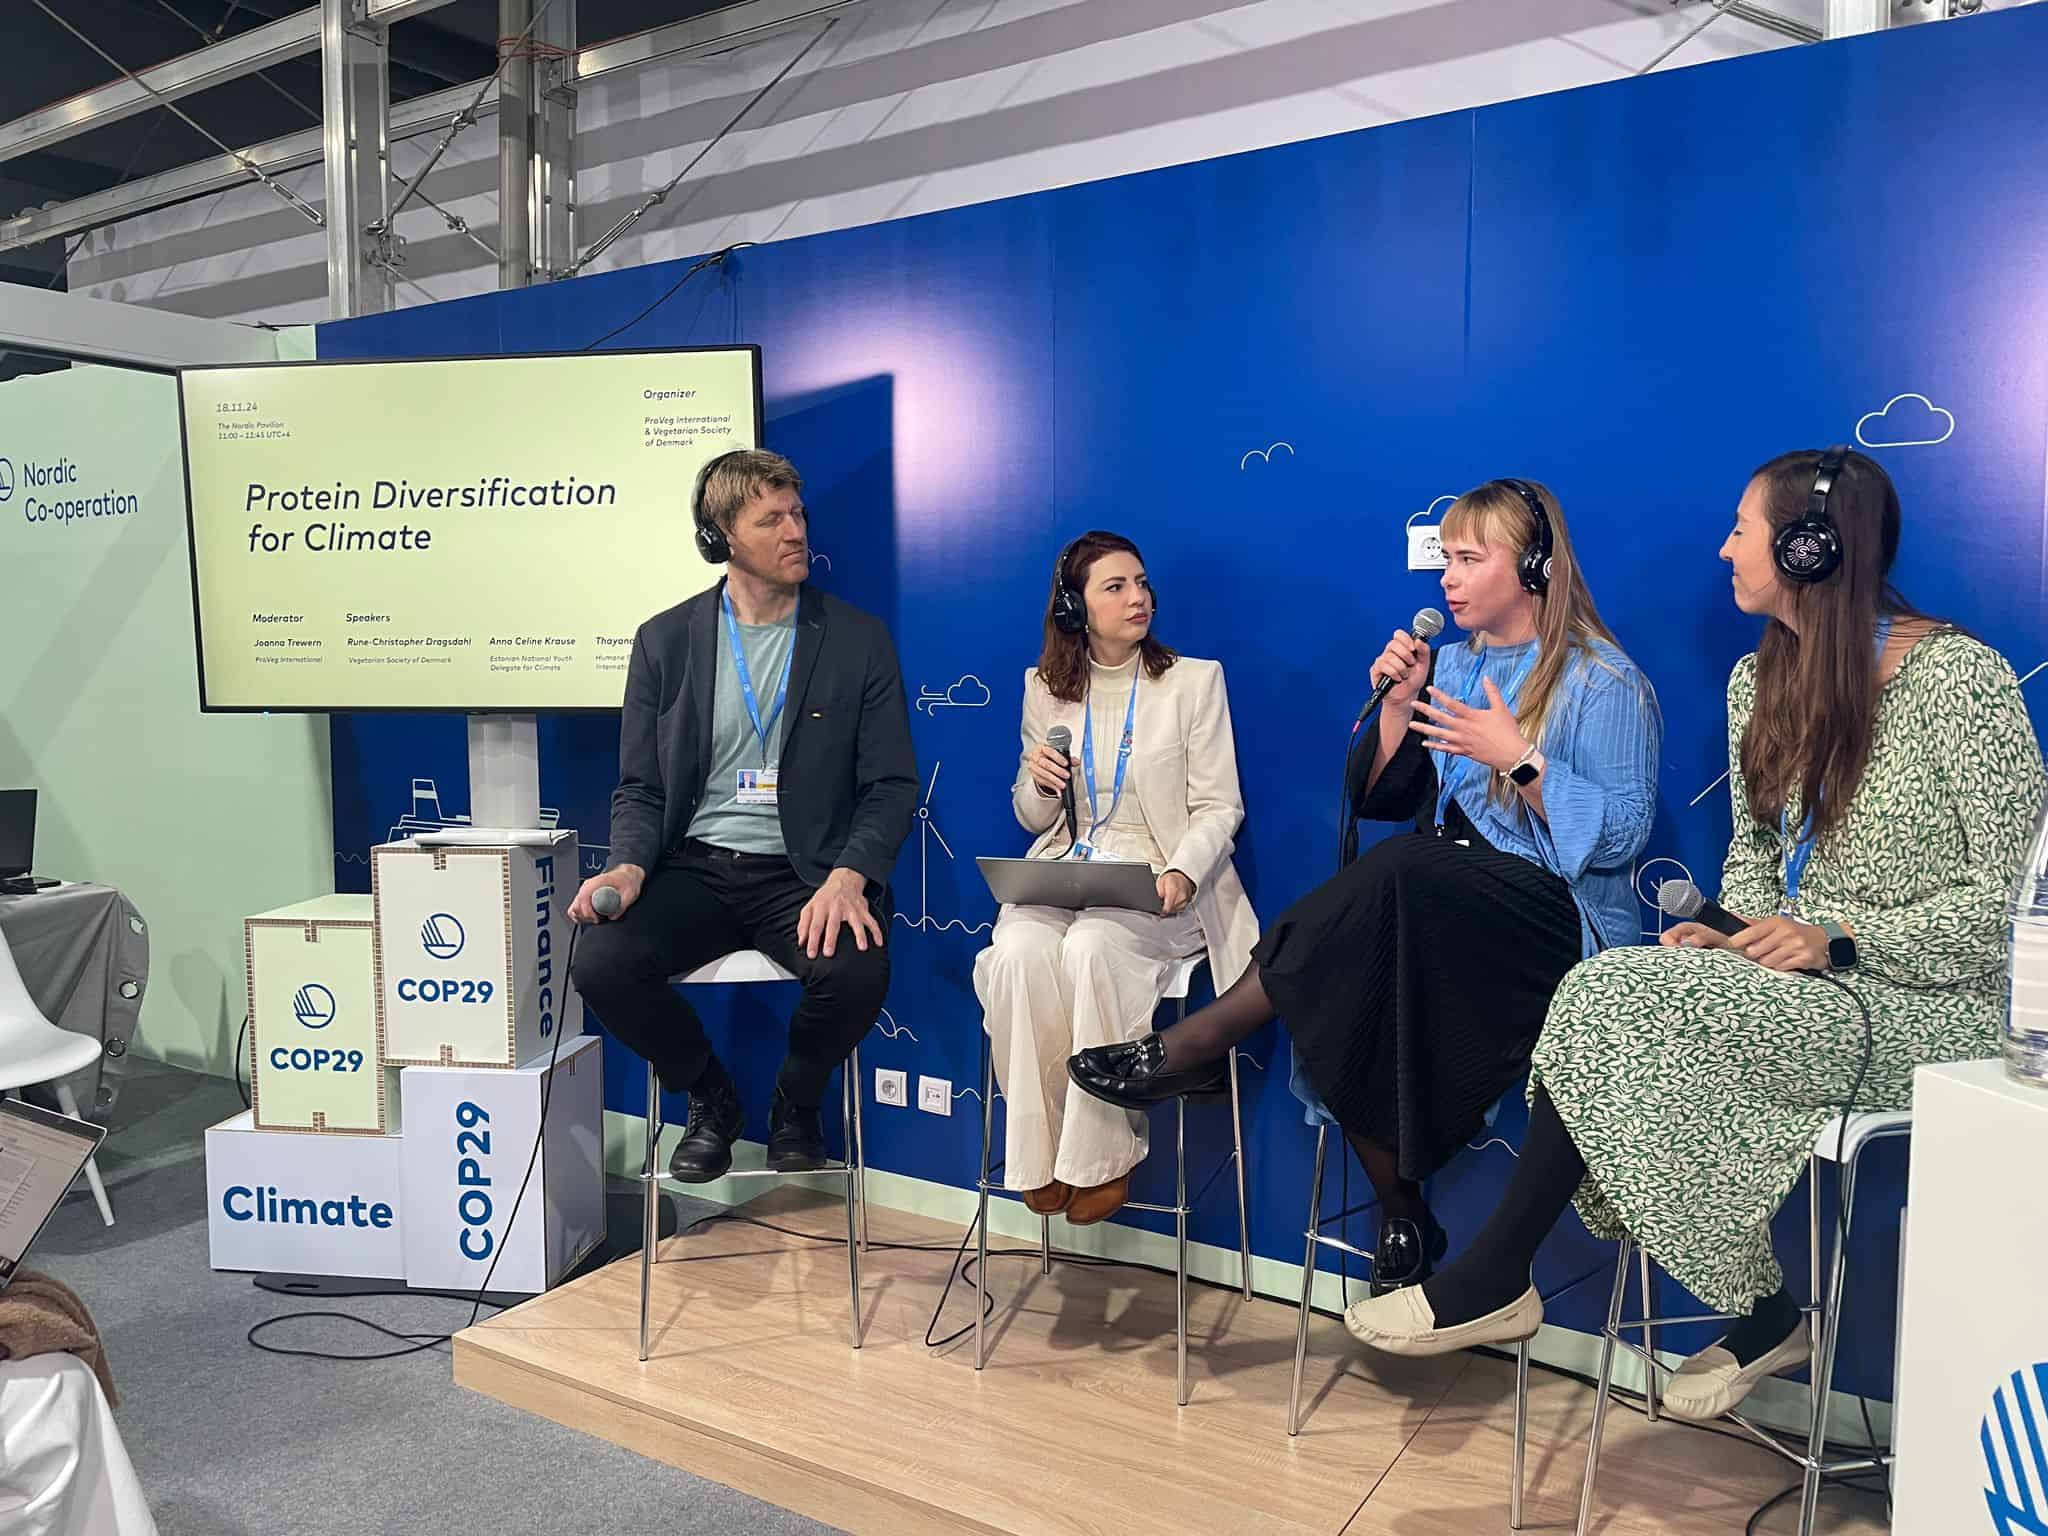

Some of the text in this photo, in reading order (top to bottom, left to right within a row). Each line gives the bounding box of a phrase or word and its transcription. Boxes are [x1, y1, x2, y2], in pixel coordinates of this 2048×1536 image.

[643, 388, 697, 401] Organizer
[216, 402, 258, 413] 18.11.24
[218, 422, 230, 430] The
[644, 414, 731, 426] ProVeg International
[644, 425, 732, 437] & Vegetarian Society
[645, 438, 693, 447] of Denmark
[24, 457, 77, 488] Nordic
[246, 475, 617, 512] Protein Diversification
[25, 488, 138, 526] Co-operation
[248, 522, 432, 552] for Climate
[252, 613, 305, 623] Moderator
[345, 612, 392, 624] Speakers
[255, 638, 323, 647] Joanna Trewern
[347, 637, 472, 647] Rune-Christopher Dragsdahl
[490, 636, 577, 646] Anna Celine Krause
[490, 664, 521, 673] Delegate
[535, 855, 555, 1039] Finance
[398, 979, 495, 1004] COP29
[270, 1047, 364, 1073] COP29
[455, 1101, 494, 1261] COP29
[223, 1185, 393, 1229] Climate
